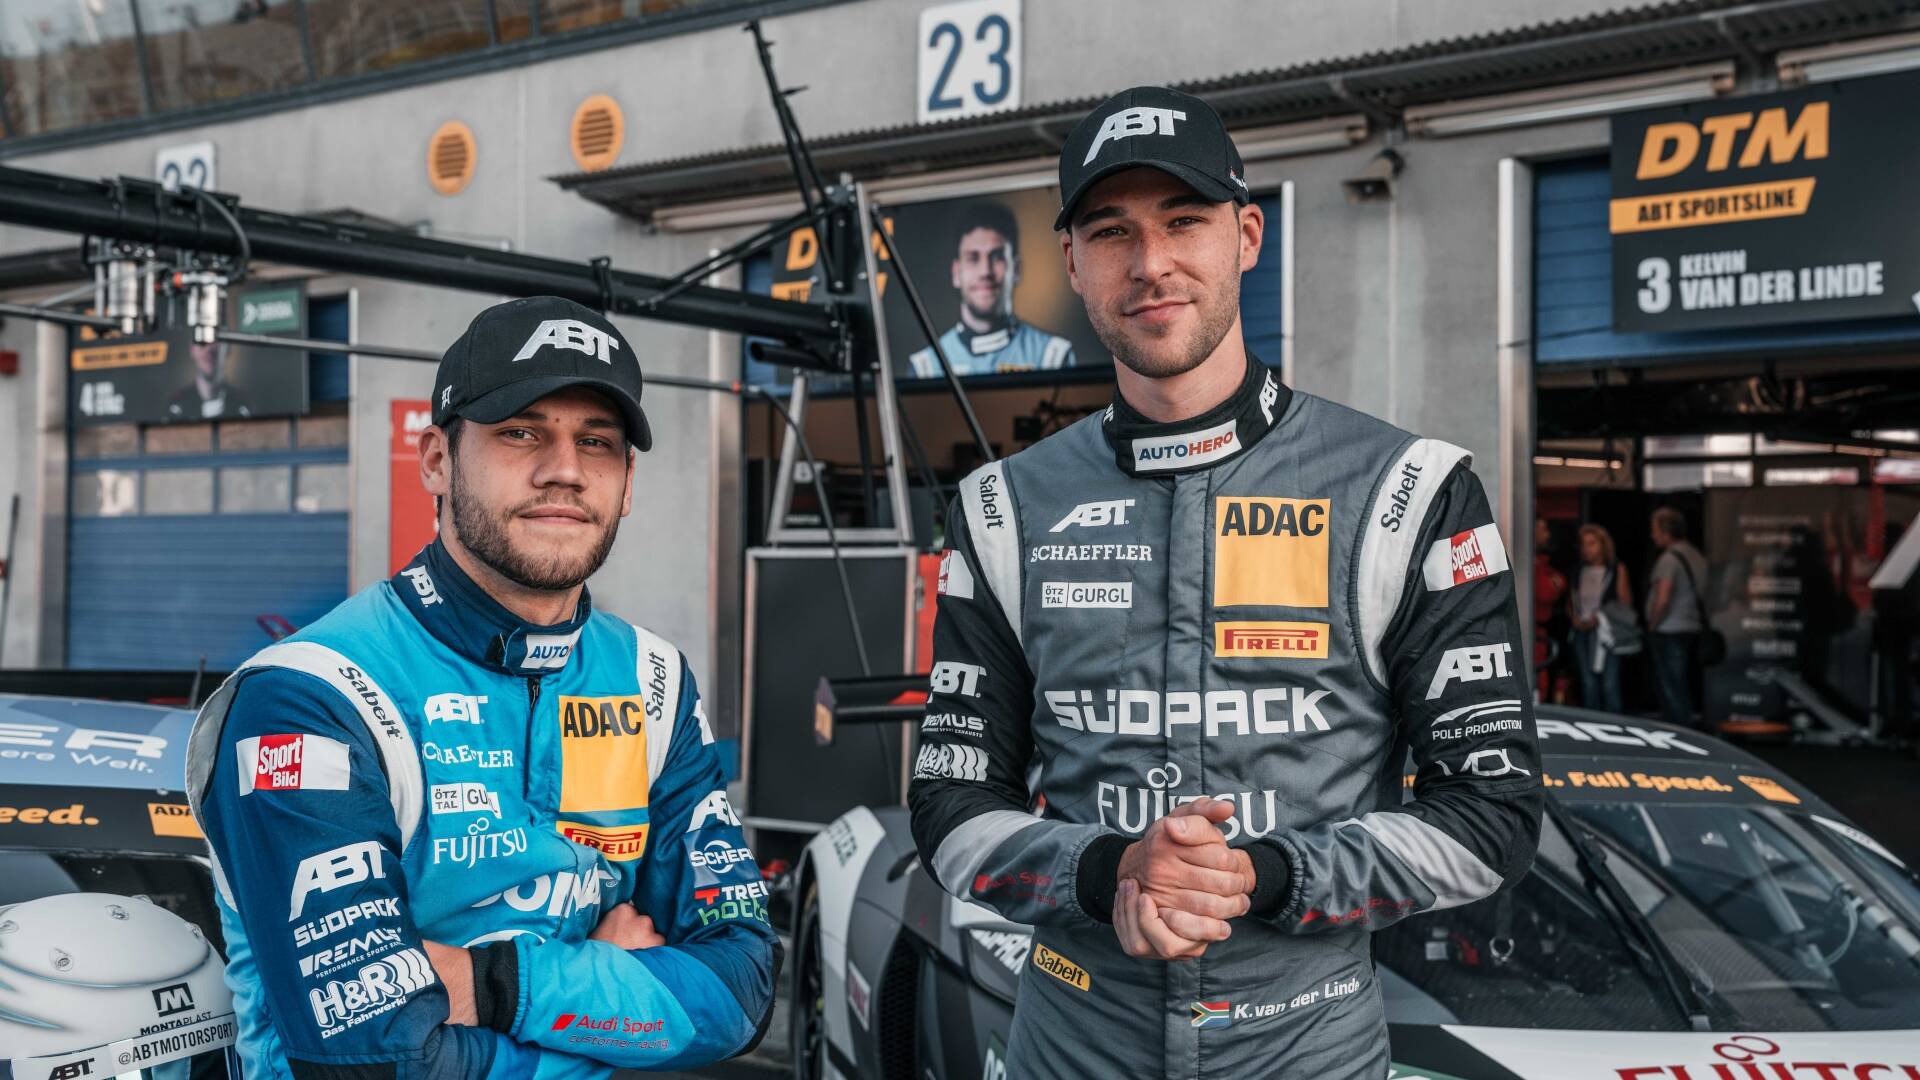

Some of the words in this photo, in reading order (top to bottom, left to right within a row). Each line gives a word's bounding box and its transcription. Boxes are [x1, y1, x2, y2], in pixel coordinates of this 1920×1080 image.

[928, 14, 1011, 112] 23
[1083, 106, 1186, 166] ABT
[1636, 101, 1829, 180] DTM
[1638, 203, 1672, 224] ABT
[1679, 187, 1796, 220] SPORTSLINE
[1679, 249, 1747, 278] KELVIN
[1637, 257, 1672, 314] 3
[1679, 275, 1736, 311] VAN
[1739, 269, 1796, 306] DER
[1799, 261, 1884, 301] LINDE
[512, 319, 619, 365] ABT
[1138, 431, 1234, 461] AUTOHERO
[979, 473, 1003, 530] Sabelt
[1380, 461, 1422, 533] Sabelt
[1048, 498, 1136, 533] ABT
[1221, 502, 1325, 537] ADAC
[1030, 544, 1153, 563] SCHAEFFLER
[1463, 561, 1486, 580] Bild
[1045, 585, 1064, 595] ÖTZ
[1045, 596, 1063, 604] TAL
[1071, 588, 1130, 603] GURGL
[529, 644, 573, 660] AUTO
[1224, 629, 1319, 652] PIRELLI
[646, 650, 667, 721] Sabelt
[1425, 642, 1512, 701] ABT
[338, 666, 403, 739] Sabelt
[424, 693, 489, 725] ABT
[563, 701, 642, 738] ADAC
[1044, 687, 1333, 738] SÜDPACK
[1432, 726, 1463, 741] POLE
[1464, 719, 1522, 738] PROMOTION
[1537, 717, 1709, 756] ACK
[70, 752, 154, 774] Welt.
[258, 738, 303, 777] Sport
[422, 742, 514, 768] CAELER
[272, 771, 299, 788] Bild
[434, 788, 458, 800] ÖTZ
[1567, 771, 1630, 788] Full
[1631, 773, 1734, 793] Speed.
[435, 800, 458, 810] TAL
[433, 826, 528, 869] FUJITSU
[288, 840, 391, 923] ABT
[293, 897, 401, 949] SÜDPACK
[315, 954, 366, 980] PERFORMANCE
[366, 943, 389, 958] SPORT
[1037, 947, 1085, 986] Sabelt
[309, 961, 405, 1028] H&R
[1290, 990, 1320, 1009] der
[140, 1011, 214, 1037] MONTAPLAST
[321, 1024, 346, 1040] Das
[575, 1015, 618, 1032] Audi
[118, 1021, 234, 1066] @ABTMOTORSPORT
[48, 1057, 96, 1080] ABT
